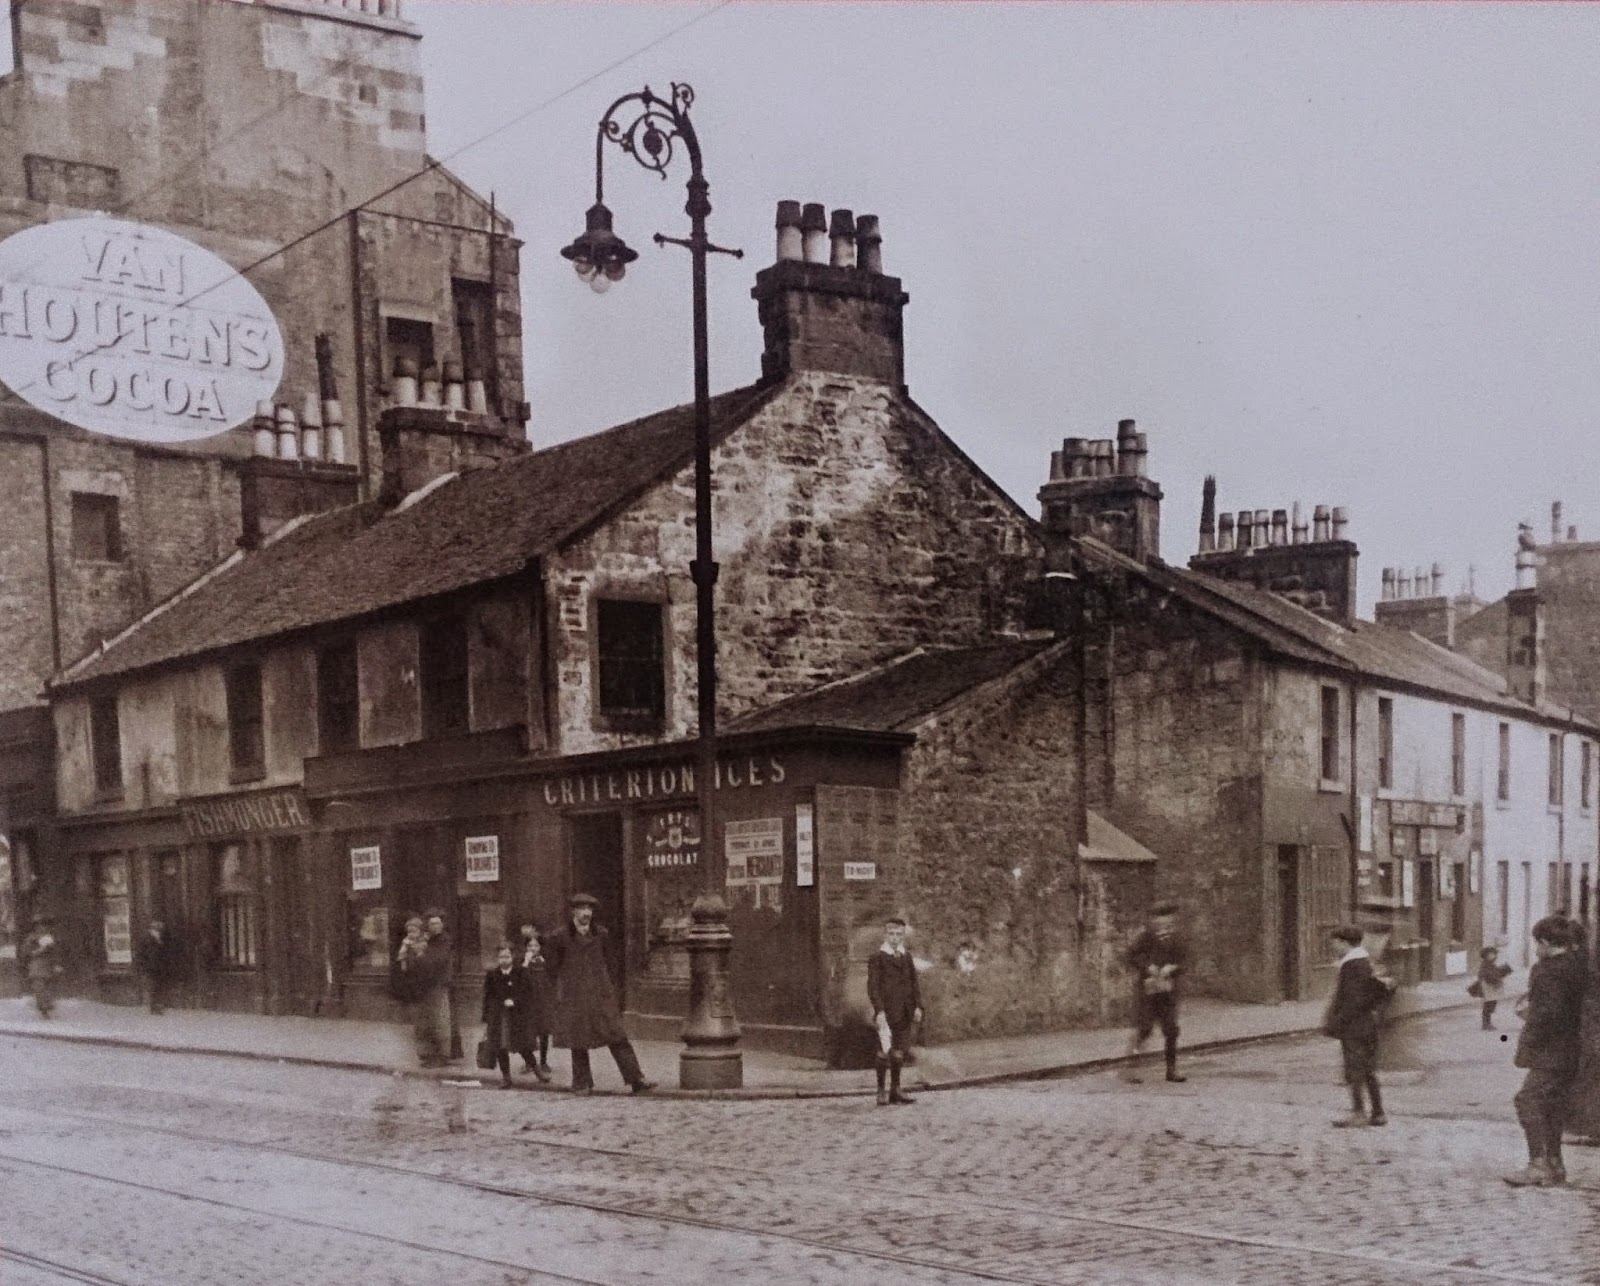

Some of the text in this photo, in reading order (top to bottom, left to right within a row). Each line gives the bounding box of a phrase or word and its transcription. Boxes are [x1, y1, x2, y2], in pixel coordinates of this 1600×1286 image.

[79, 234, 185, 297] VAN
[45, 359, 228, 422] COCOA
[543, 756, 786, 805] CRITERION ICES
